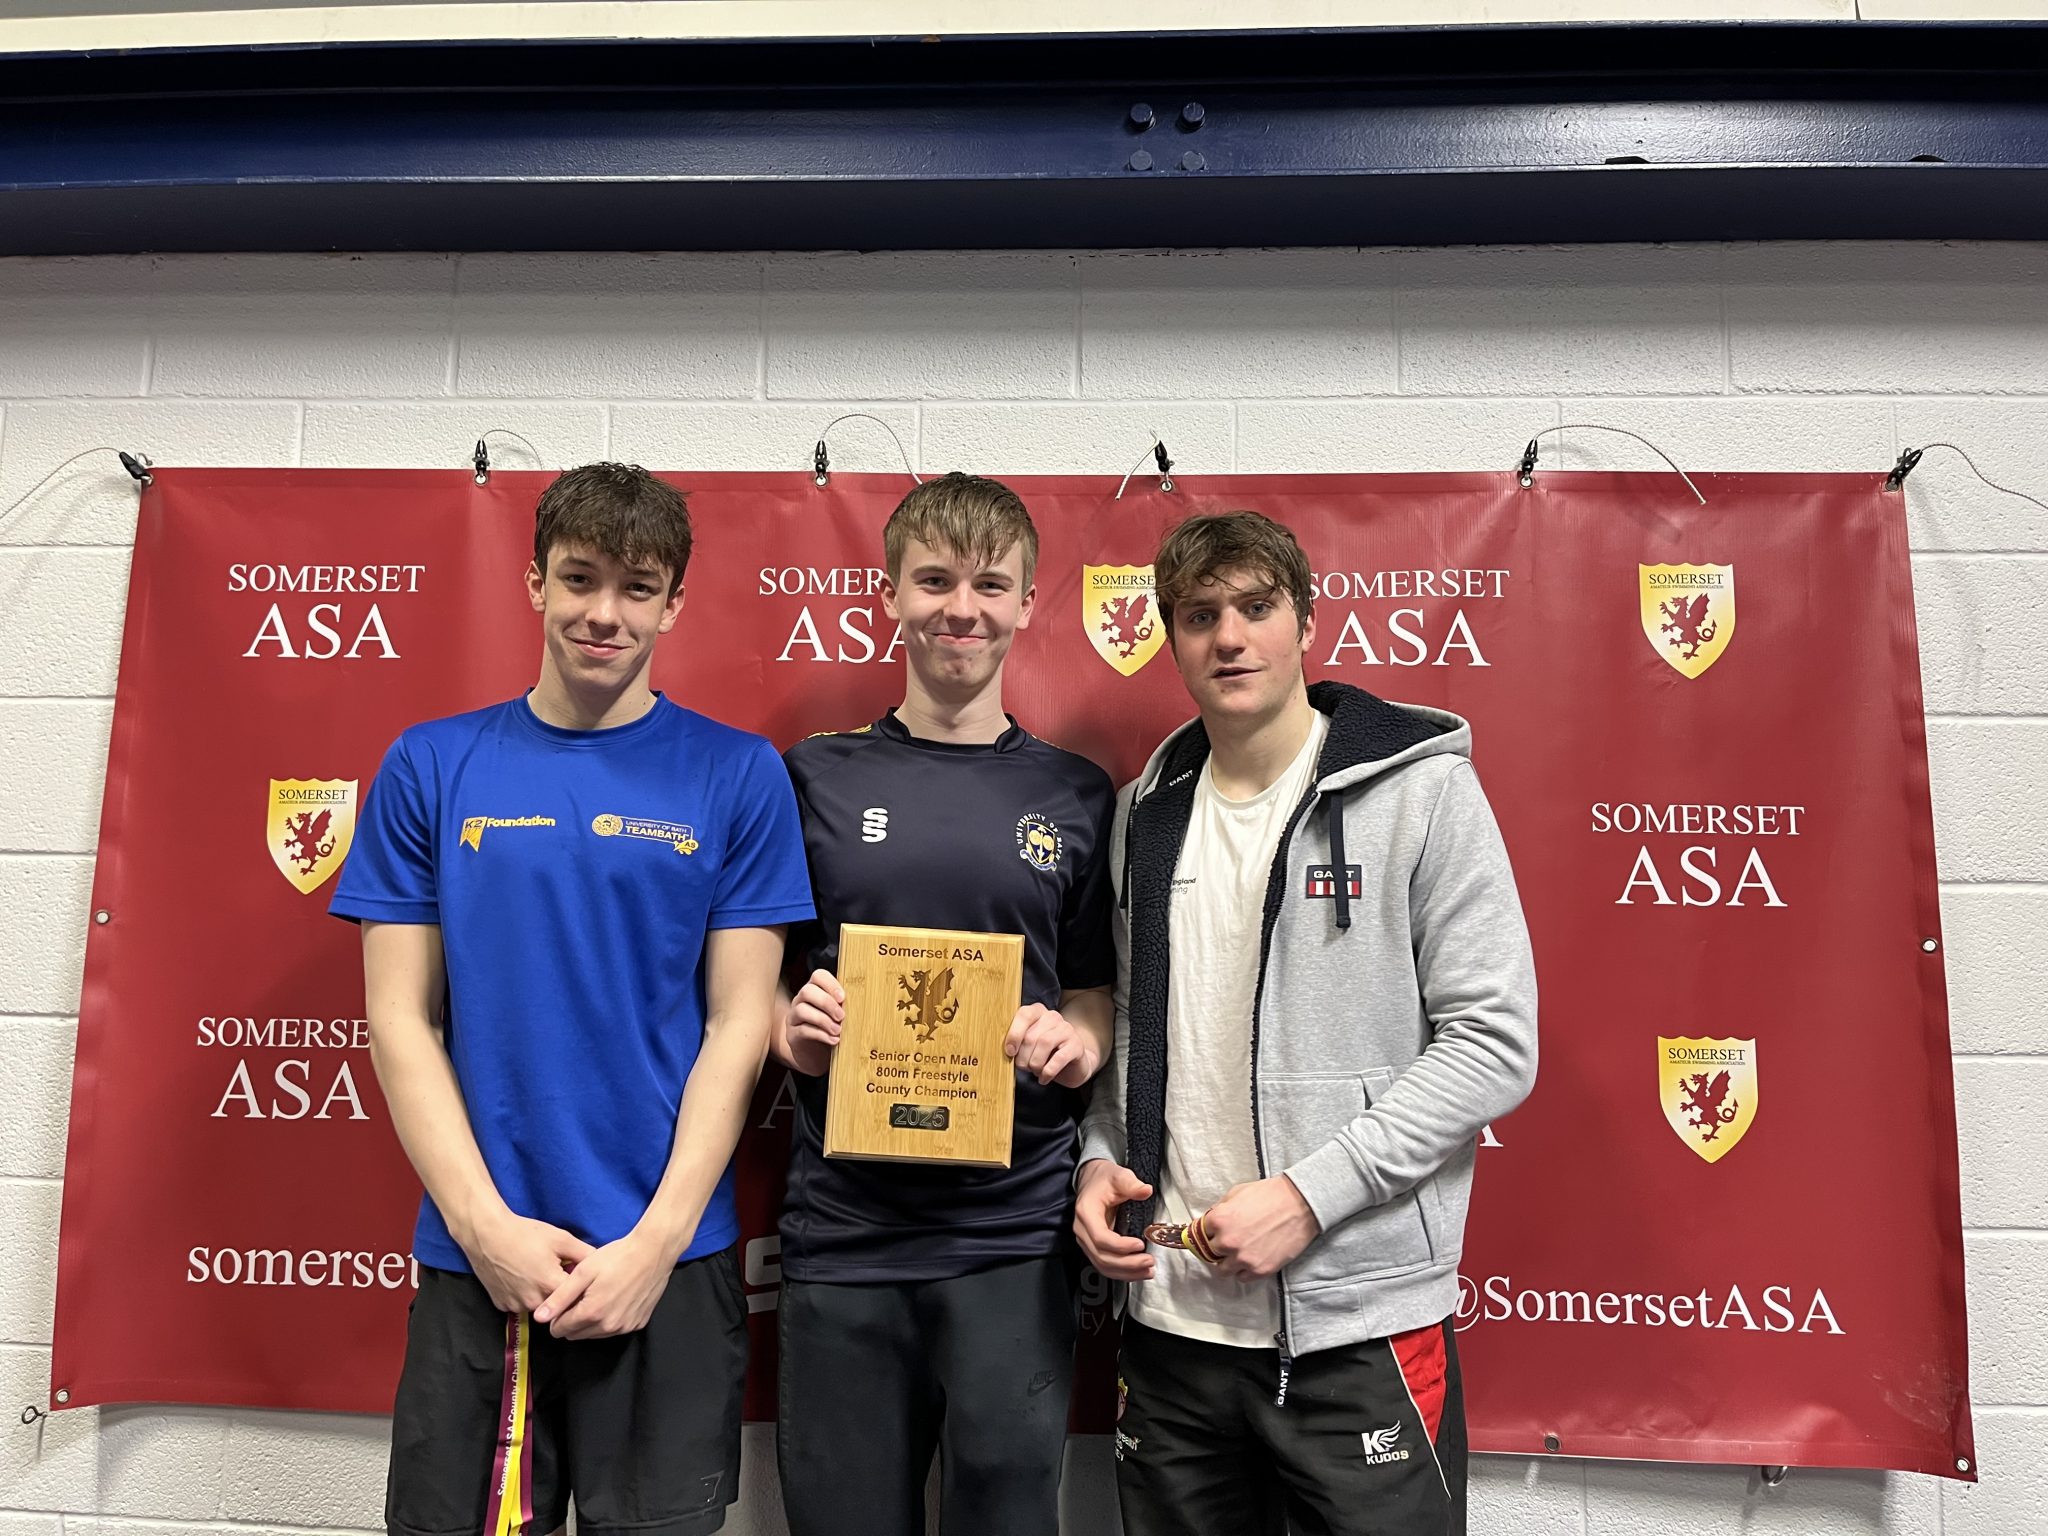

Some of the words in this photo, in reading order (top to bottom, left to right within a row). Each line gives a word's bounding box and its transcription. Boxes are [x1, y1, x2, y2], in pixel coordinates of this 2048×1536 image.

[228, 563, 425, 593] SOMERSET
[759, 567, 885, 596] SOMER
[1092, 574, 1155, 586] SOMERSE
[1309, 569, 1510, 600] SOMERSET
[1648, 573, 1724, 585] SOMERSET
[242, 602, 401, 659] ASA
[1323, 608, 1491, 667] ASA
[278, 788, 348, 800] SOMERSET
[465, 819, 483, 829] K2
[486, 815, 556, 827] Foundation
[625, 820, 660, 829] UNIVERSITY
[1591, 802, 1805, 835] SOMERSET
[1313, 870, 1355, 879] GAT
[1615, 845, 1788, 906] ASA
[878, 943, 949, 960] Somerset
[952, 948, 984, 961] ASA
[197, 1017, 370, 1049] SOMERSE
[869, 1049, 911, 1062] Senior
[913, 1052, 946, 1065] Open
[950, 1054, 979, 1067] Male
[1668, 1047, 1745, 1061] SOMERSET
[876, 1066, 909, 1079] 800m
[913, 1068, 970, 1084] Freestyle
[211, 1058, 370, 1120] ASA
[866, 1082, 911, 1098] County
[914, 1085, 977, 1101] Champion
[894, 1105, 945, 1128] 2025
[1366, 1450, 1410, 1465] KUDOS
